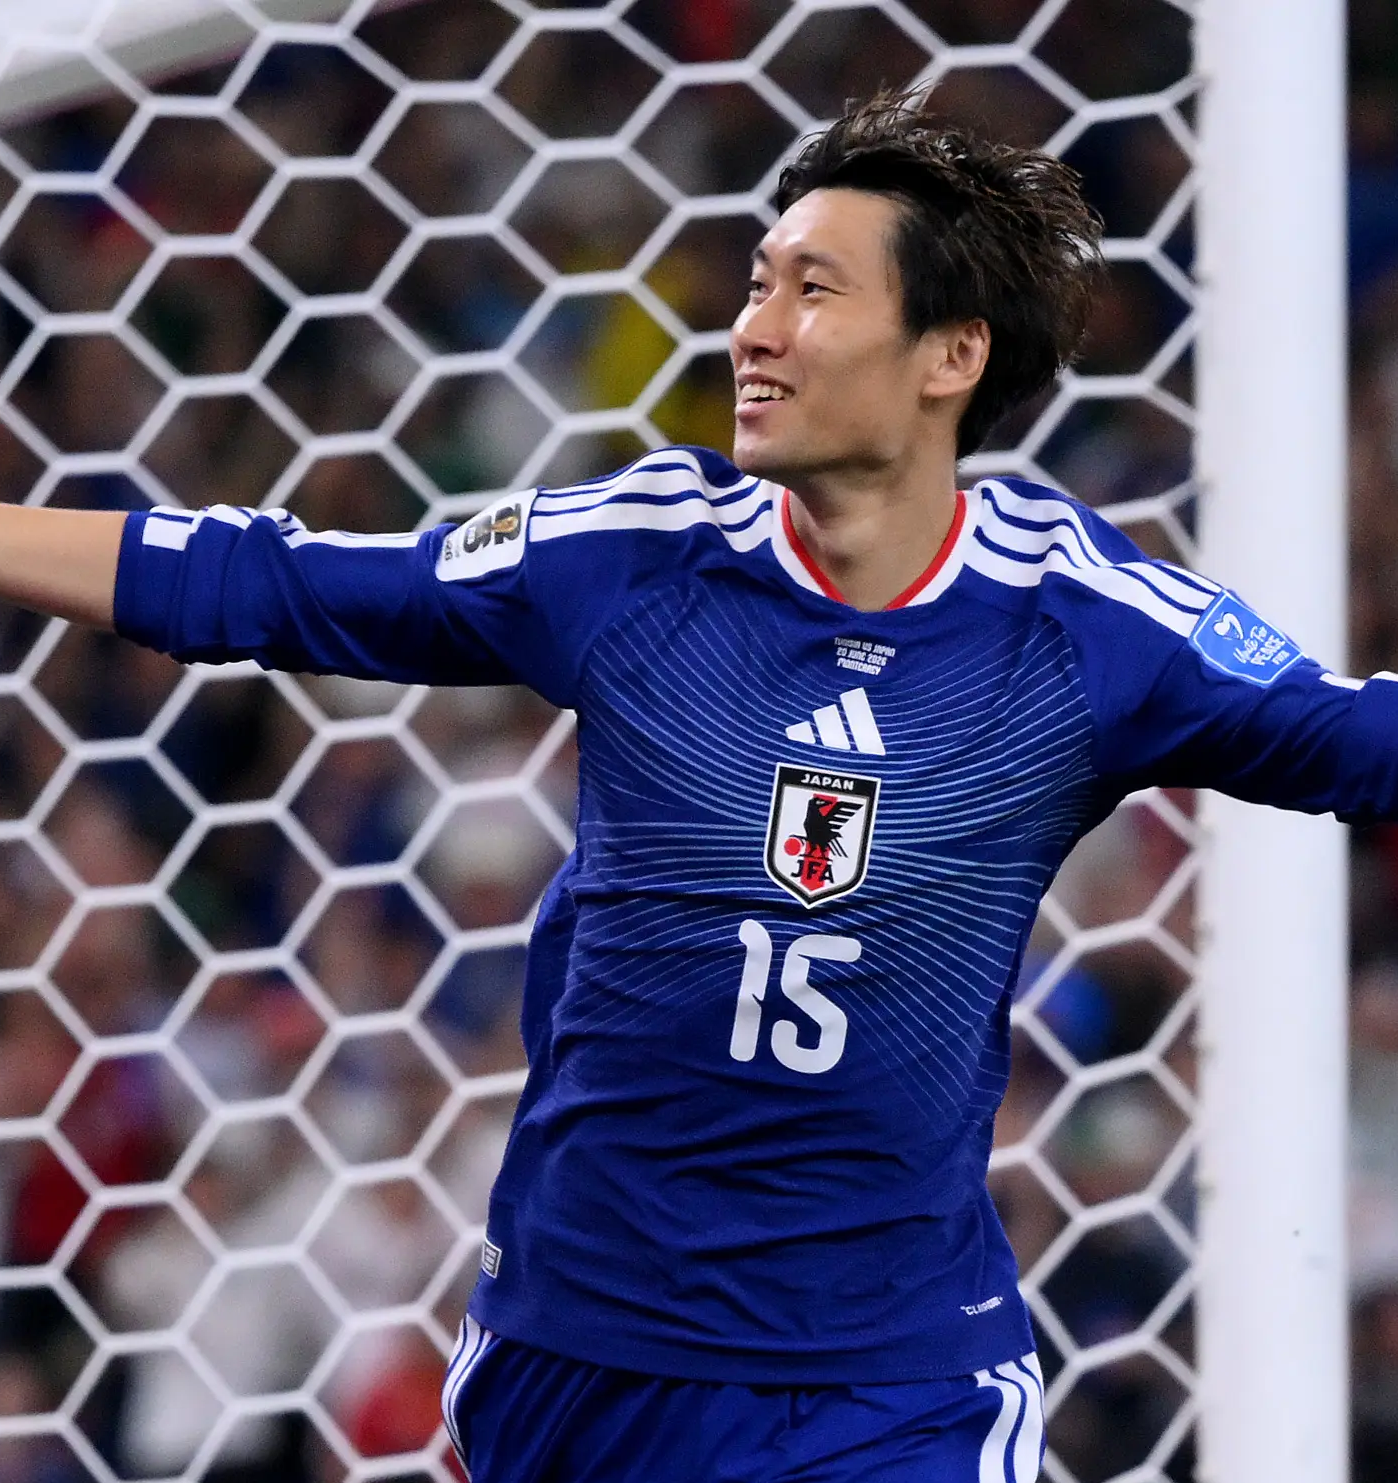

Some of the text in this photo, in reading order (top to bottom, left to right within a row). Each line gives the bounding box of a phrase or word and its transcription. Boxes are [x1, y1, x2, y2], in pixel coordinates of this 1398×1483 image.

[836, 647, 848, 657] 20
[867, 653, 888, 667] 2026
[801, 773, 854, 791] JAPAN
[790, 859, 834, 884] JFA
[730, 919, 862, 1074] 15
